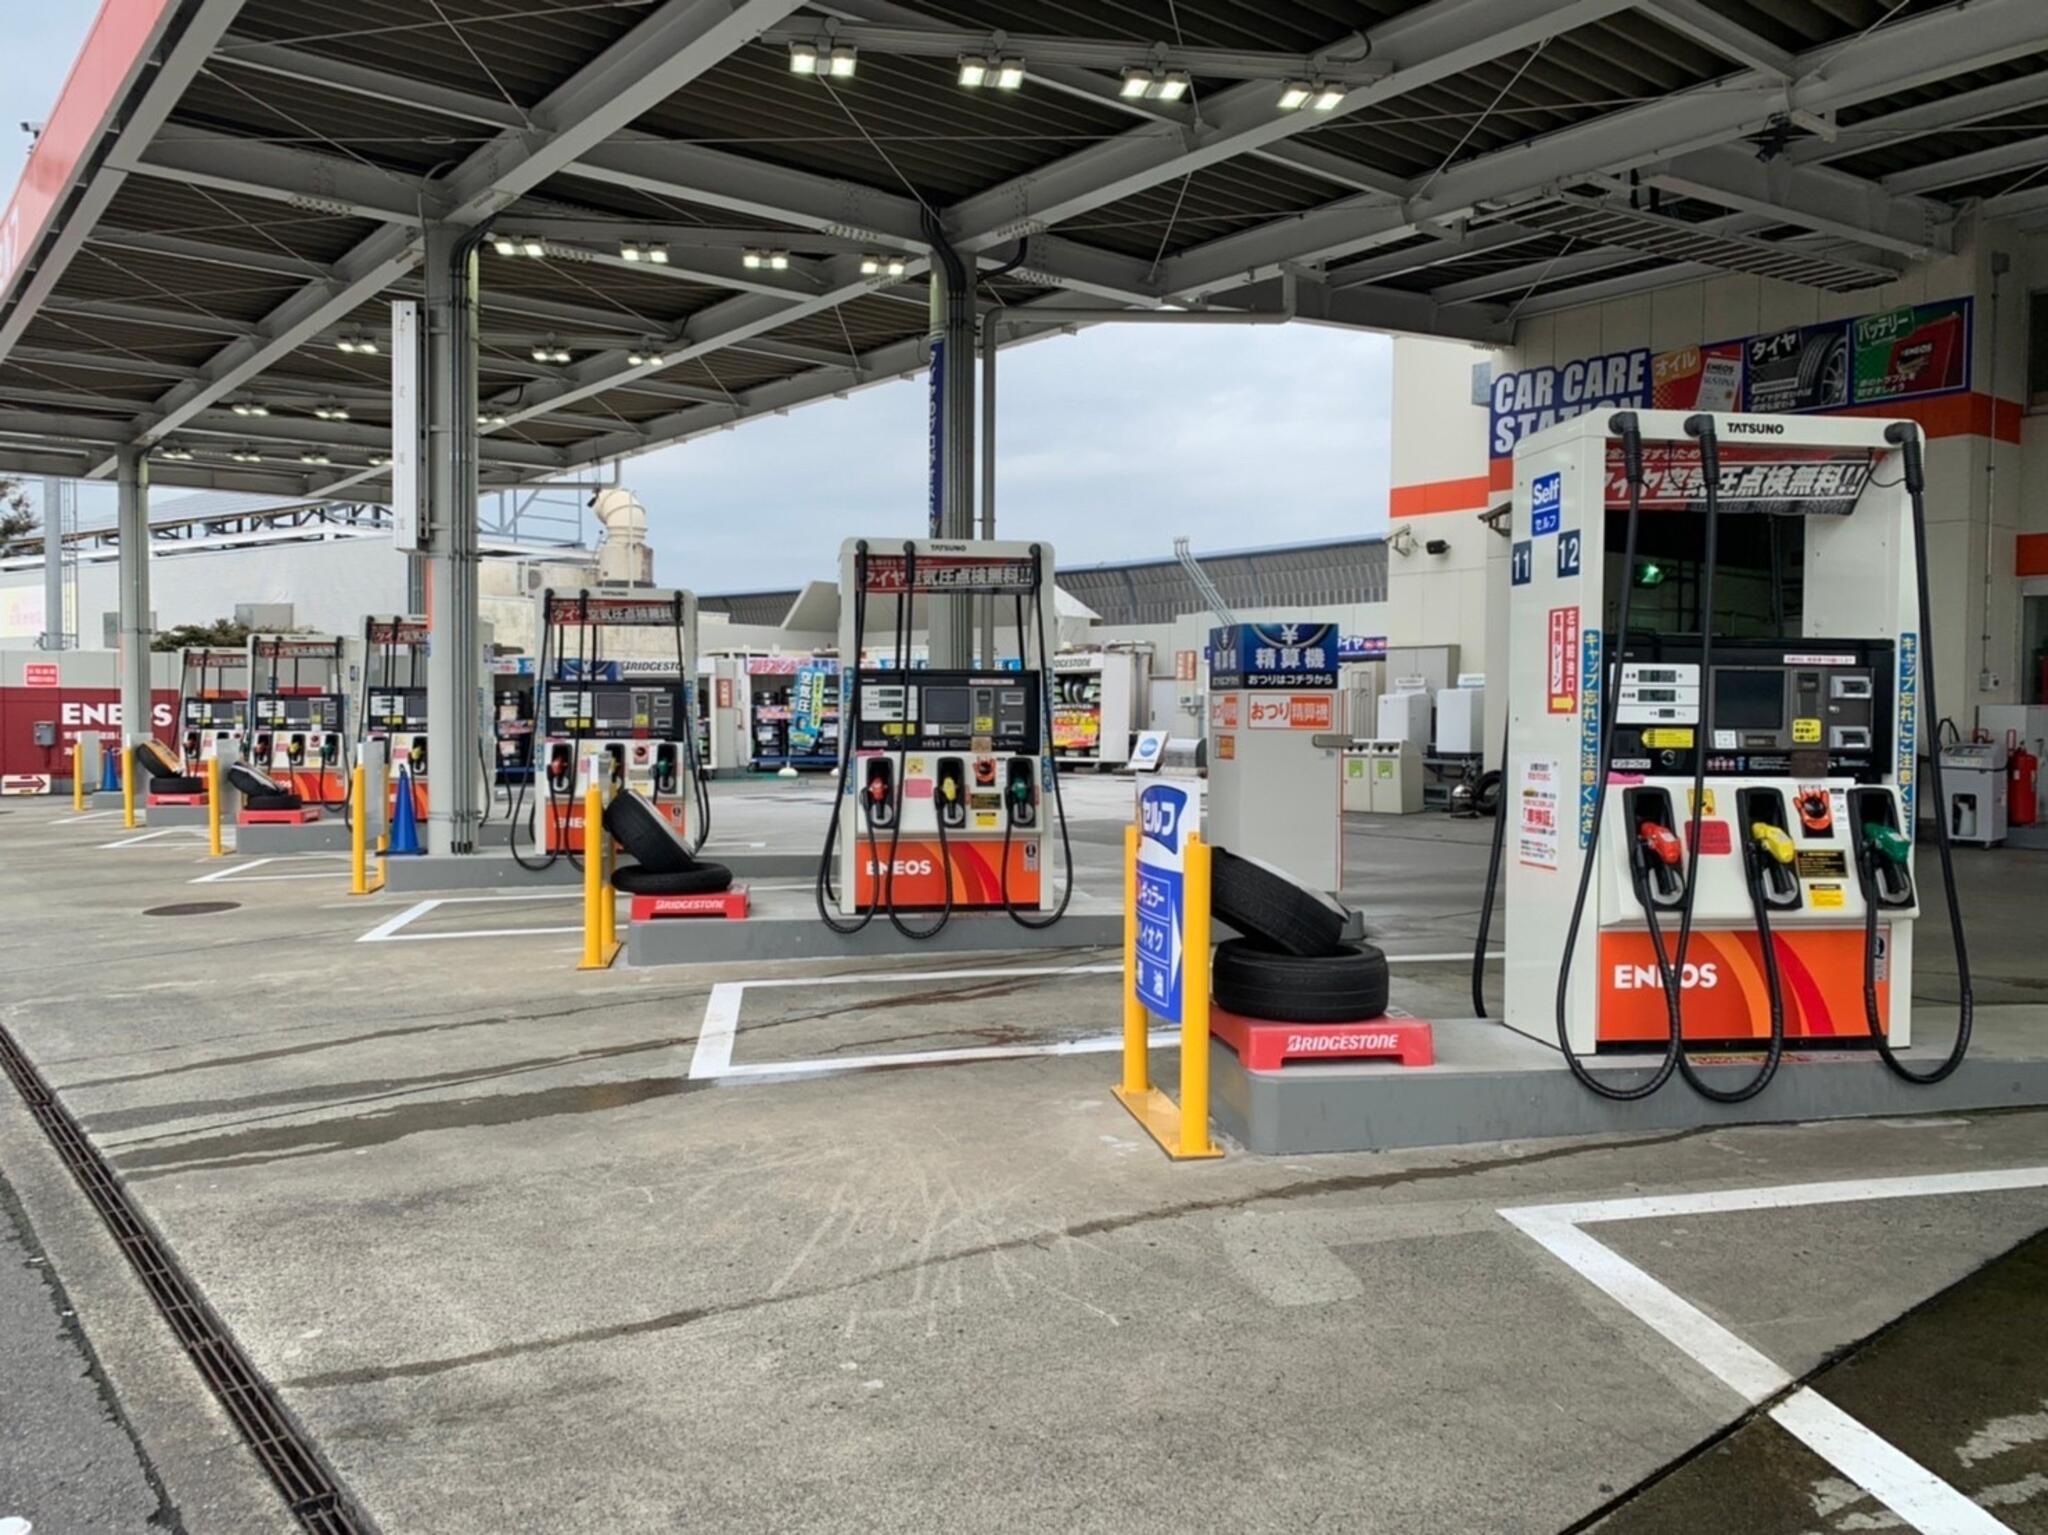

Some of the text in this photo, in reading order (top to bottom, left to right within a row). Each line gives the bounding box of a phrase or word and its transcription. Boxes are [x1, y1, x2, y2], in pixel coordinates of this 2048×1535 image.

[1858, 312, 1909, 343] バッテリー
[1751, 331, 1797, 361] タイヤ
[1656, 350, 1697, 377] オイル
[1494, 351, 1646, 414] CAR CARE
[1727, 422, 1785, 435] TATSUNO
[1533, 477, 1560, 506] Self
[1535, 515, 1557, 532] セルフ
[1514, 549, 1530, 580] 11
[1558, 537, 1579, 570] 12
[1255, 647, 1326, 670] 精算機
[1248, 675, 1333, 686] おつりはコチラから
[62, 703, 172, 726] ENES
[1143, 801, 1176, 836] セルフ
[655, 898, 726, 910] BRIDGESTONE
[1286, 1034, 1399, 1052] BRIDGESTONE
